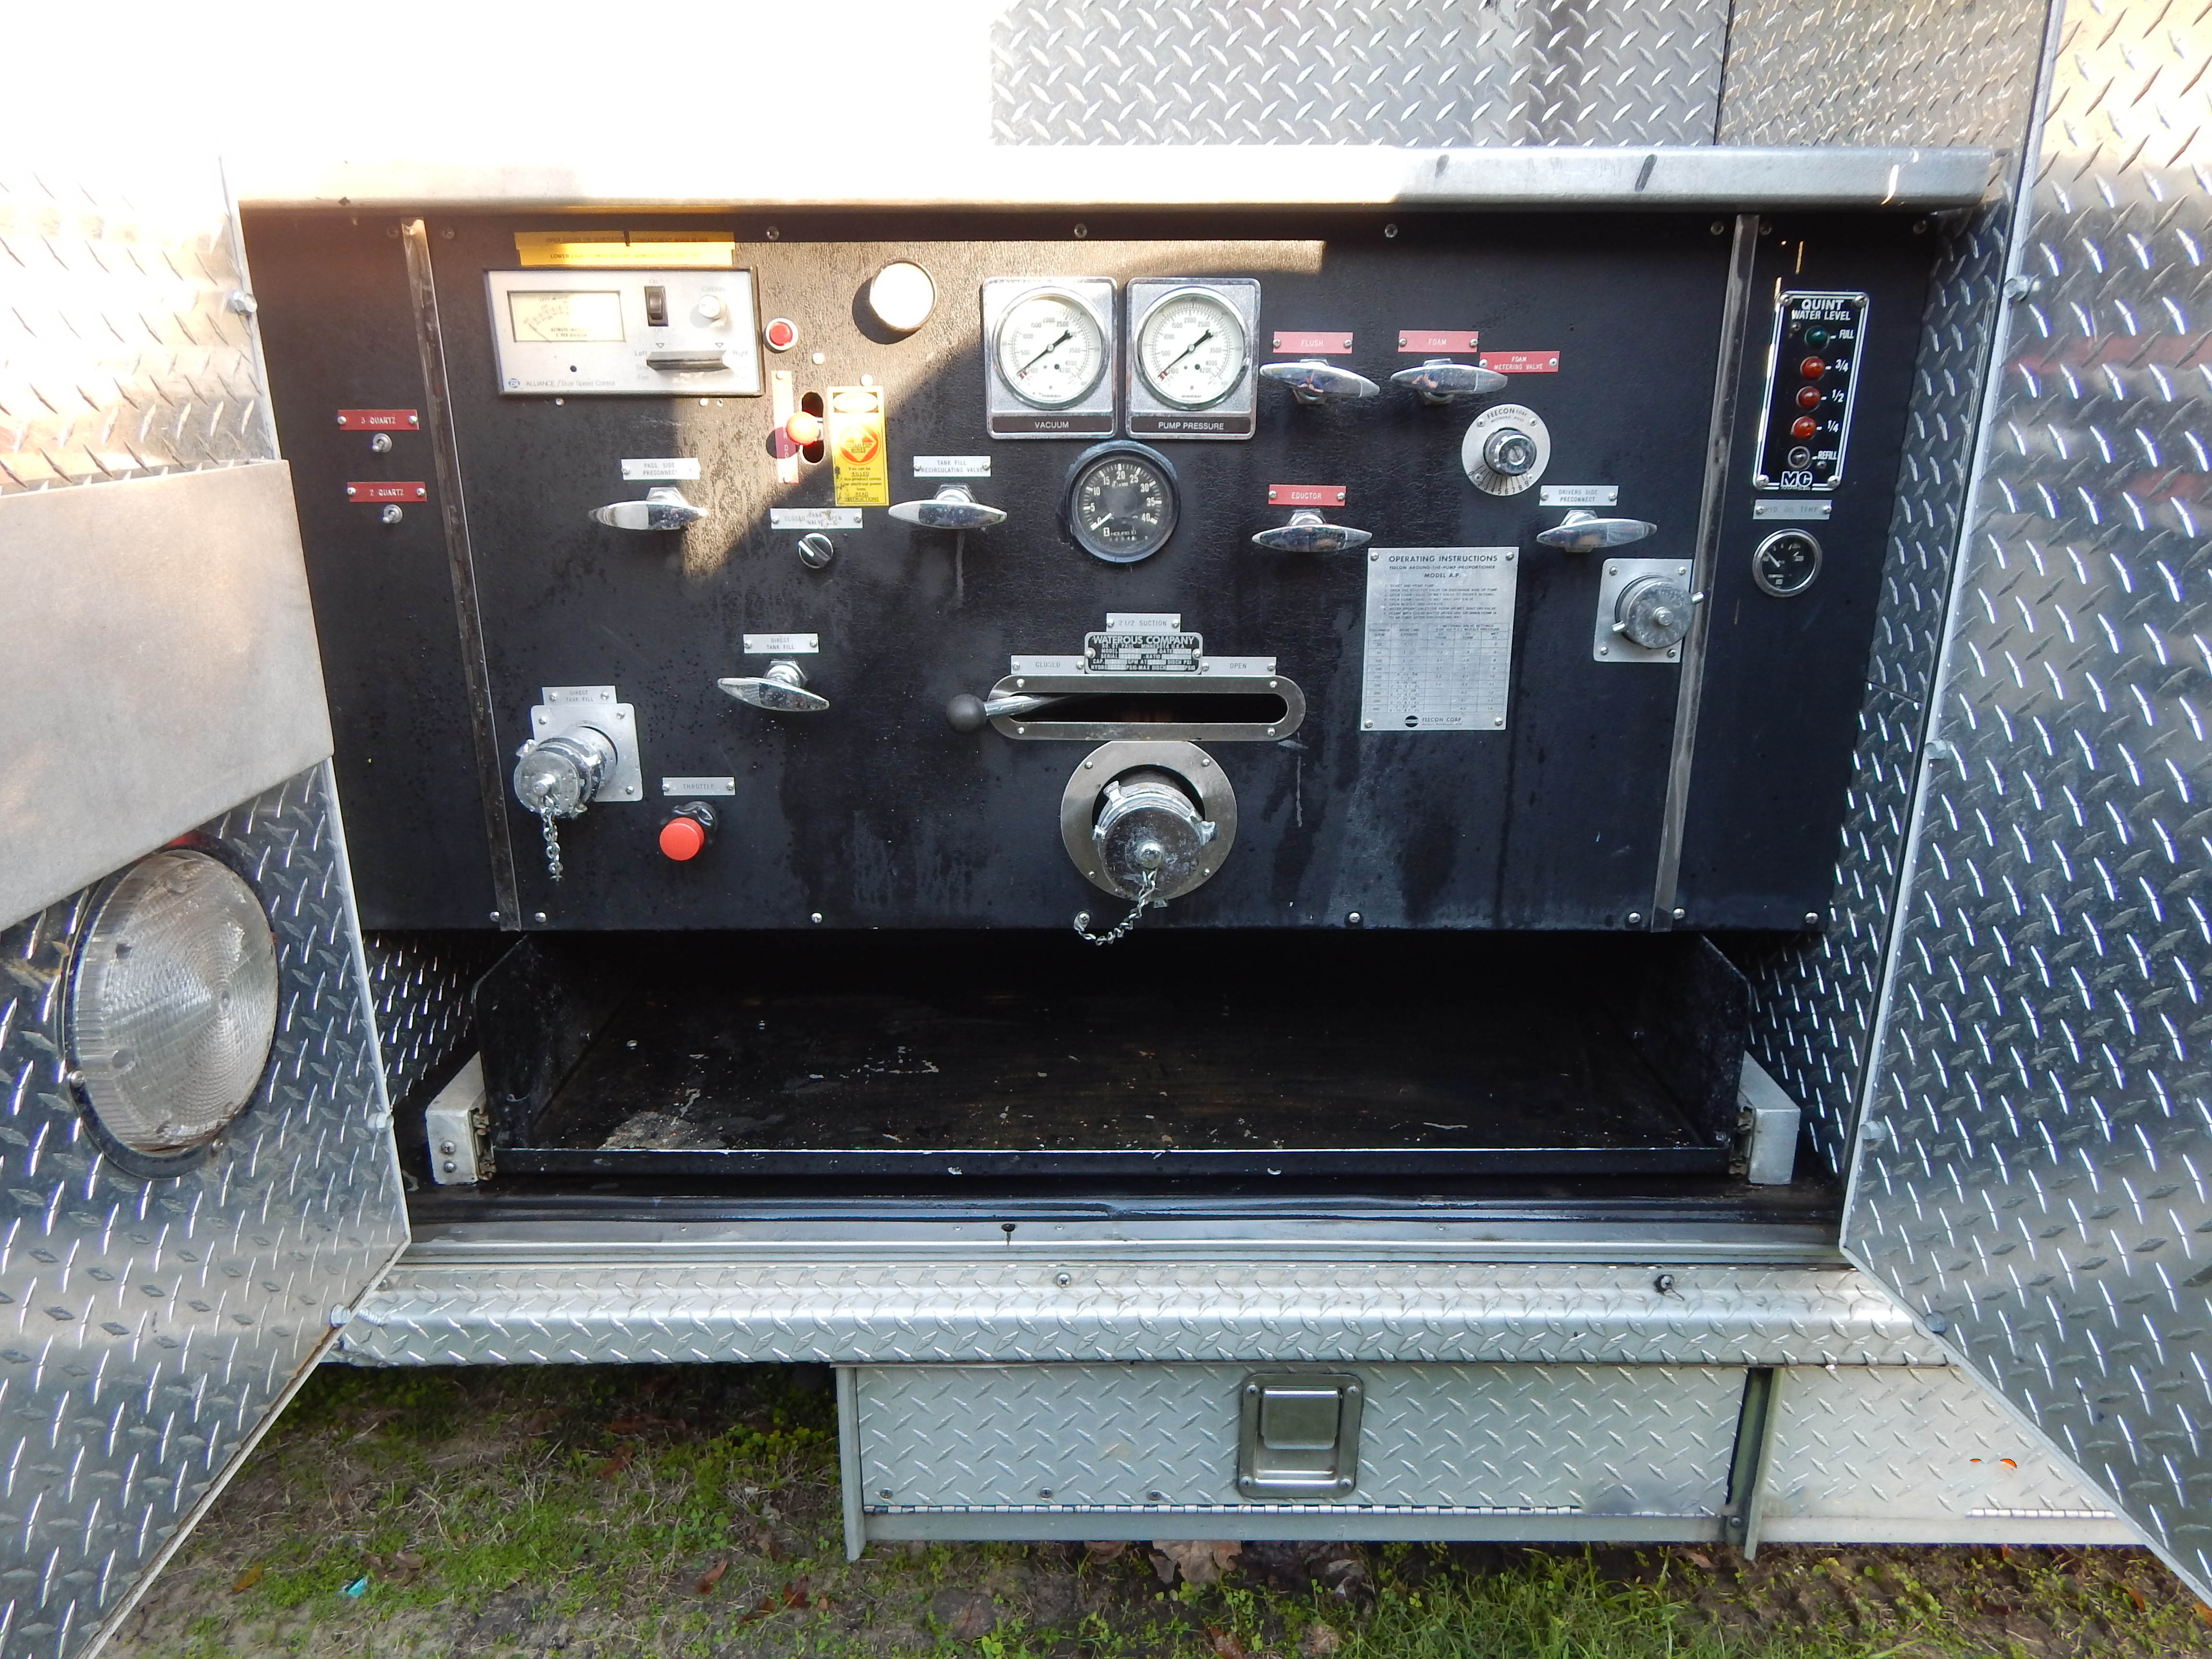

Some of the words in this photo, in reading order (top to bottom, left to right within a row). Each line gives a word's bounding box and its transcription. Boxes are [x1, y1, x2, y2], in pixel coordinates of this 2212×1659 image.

[1801, 299, 1844, 311] QUINT
[1791, 309, 1821, 320] WATER
[1824, 311, 1851, 321] LEVEL
[1839, 329, 1854, 339] FULL
[1835, 359, 1849, 373] 3/4
[1831, 389, 1844, 402] 1/2
[1487, 408, 1515, 419] FEECON
[1183, 422, 1225, 430] PRESSURE
[1827, 420, 1839, 433] 1/4
[1817, 450, 1837, 460] REFILL
[1116, 470, 1126, 480] 20
[1130, 474, 1139, 483] 25
[1103, 476, 1110, 485] 15
[1094, 486, 1101, 495] 10
[1141, 483, 1149, 492] 30
[1146, 497, 1155, 506] 35
[1090, 503, 1095, 512] 5
[1142, 513, 1150, 522] 40
[1093, 636, 1143, 644] WATEROUS
[1146, 636, 1195, 645] COMPANY
